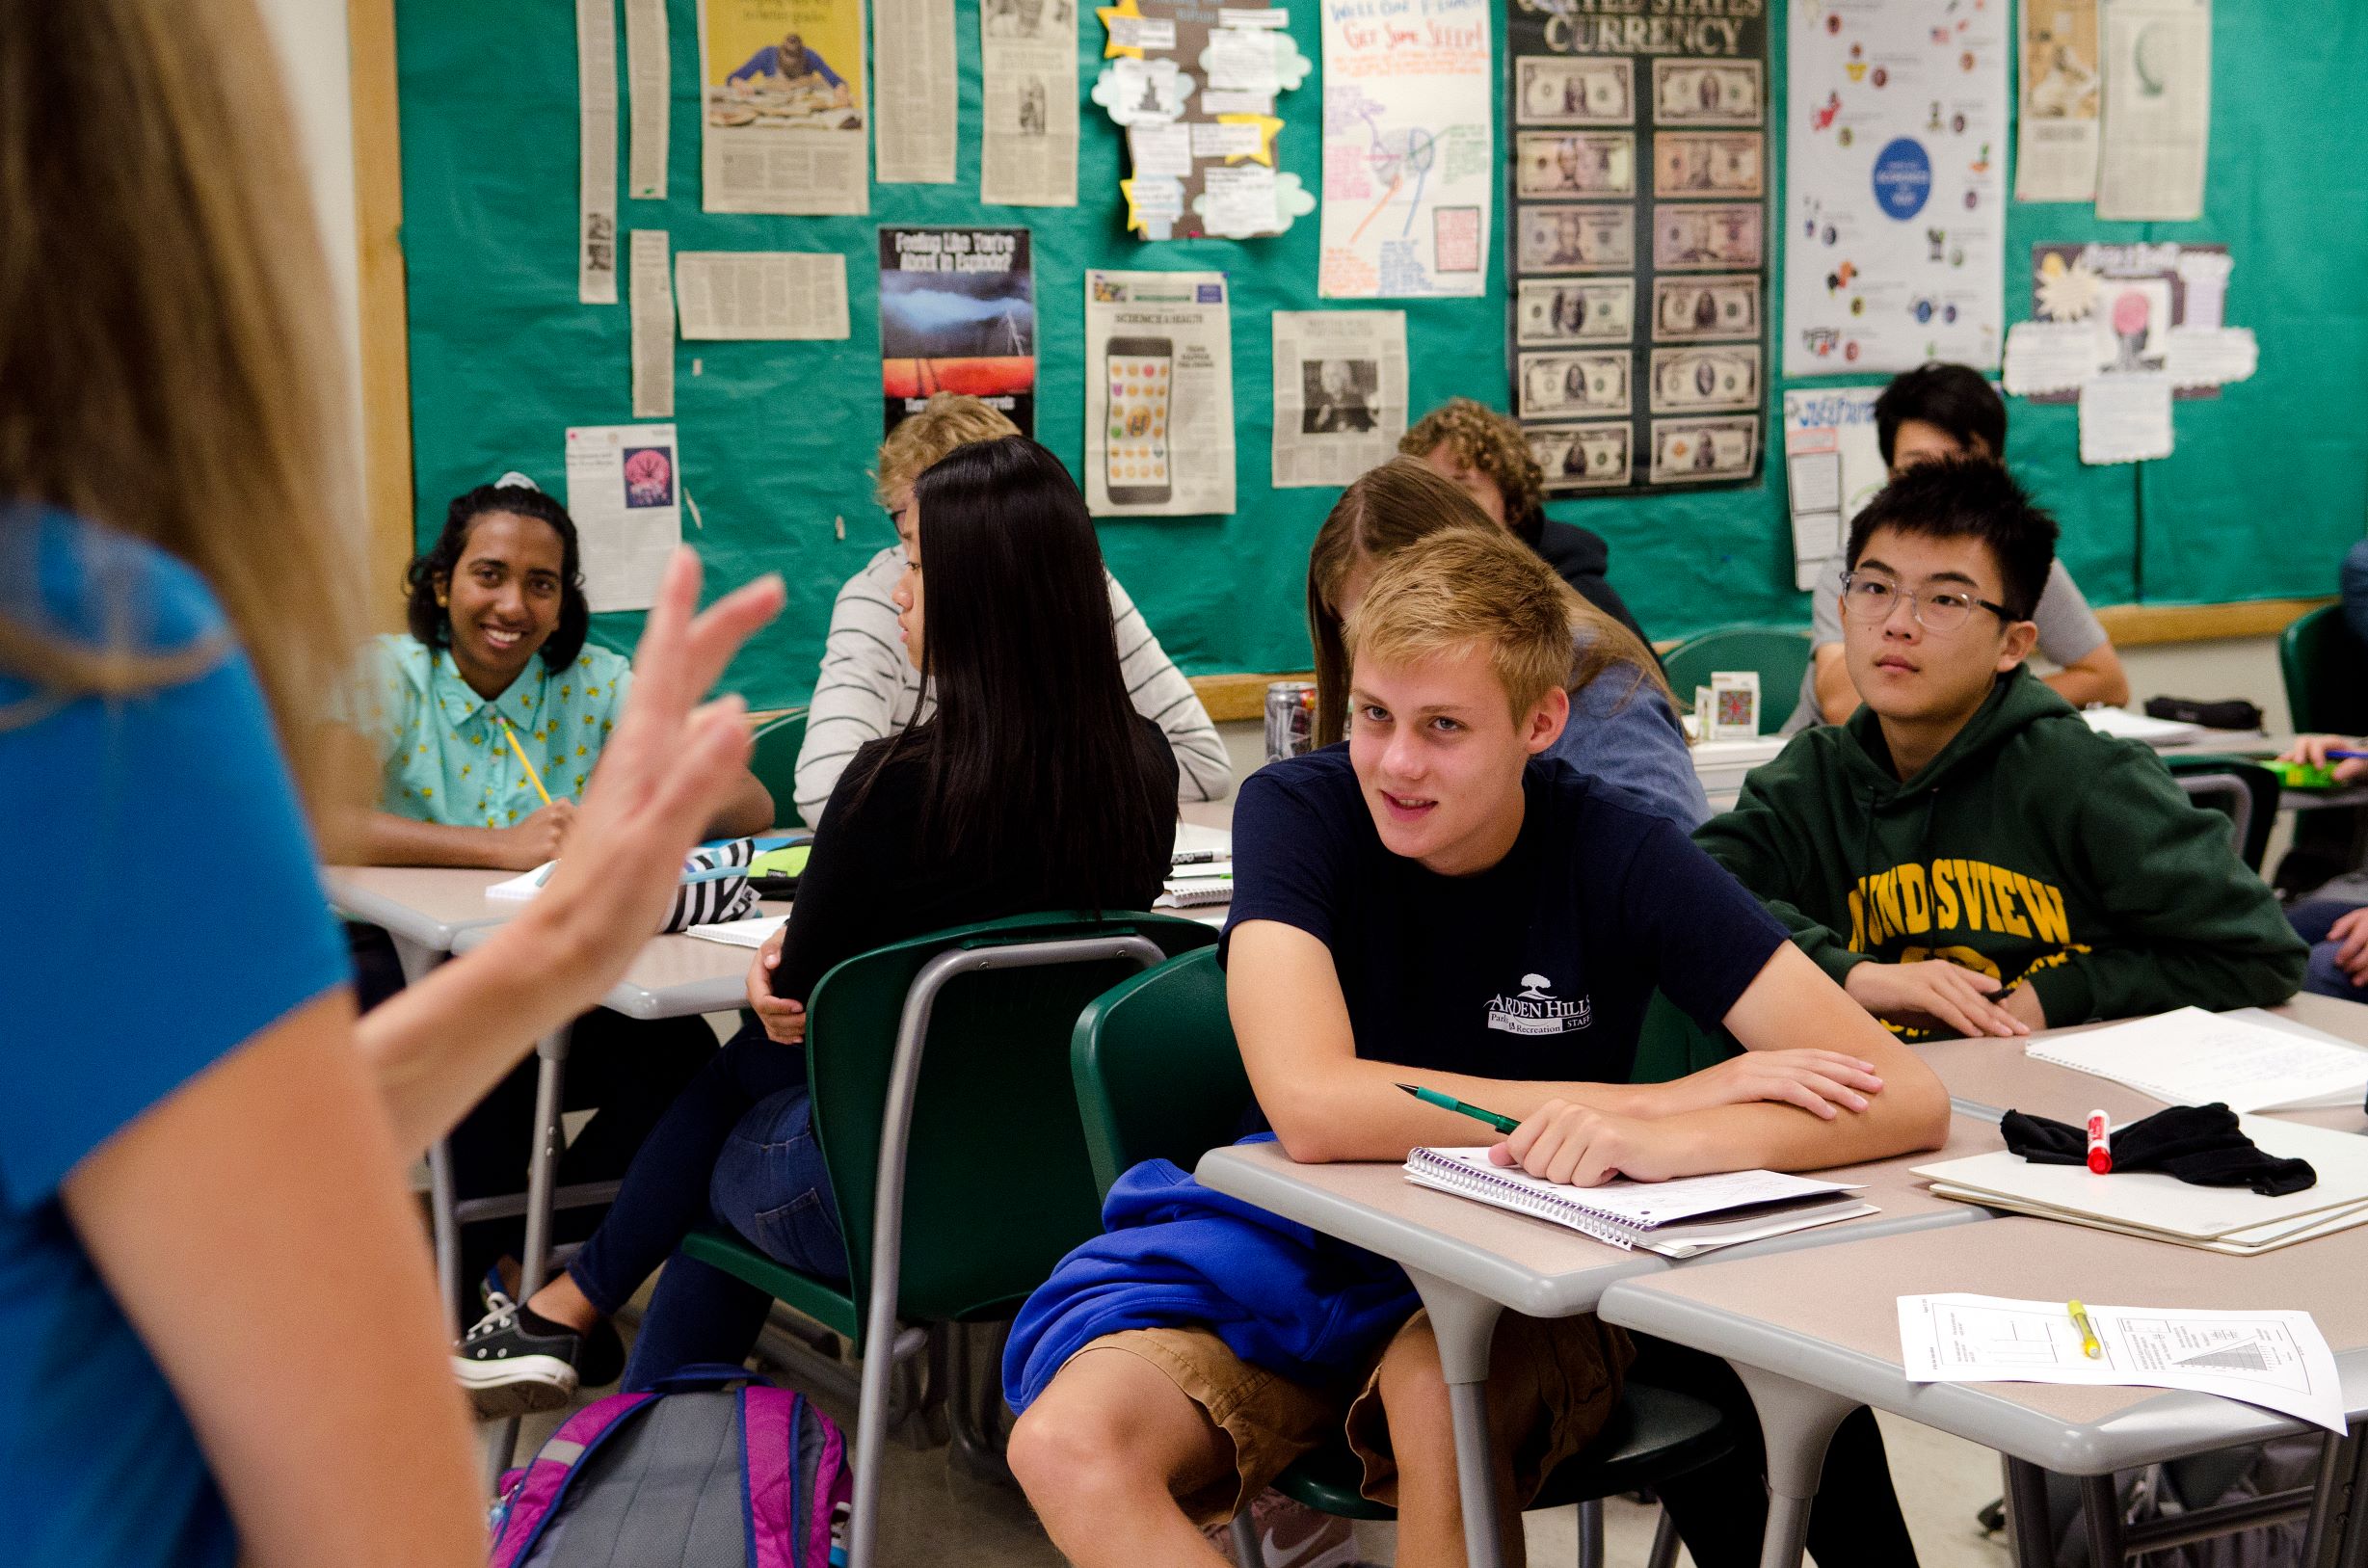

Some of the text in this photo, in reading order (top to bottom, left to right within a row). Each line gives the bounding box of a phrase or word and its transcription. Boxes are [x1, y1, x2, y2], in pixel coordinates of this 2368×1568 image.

[1543, 13, 1743, 55] CURRENCY
[1483, 994, 1542, 1018] ARDEN
[1516, 1024, 1561, 1034] Recreation
